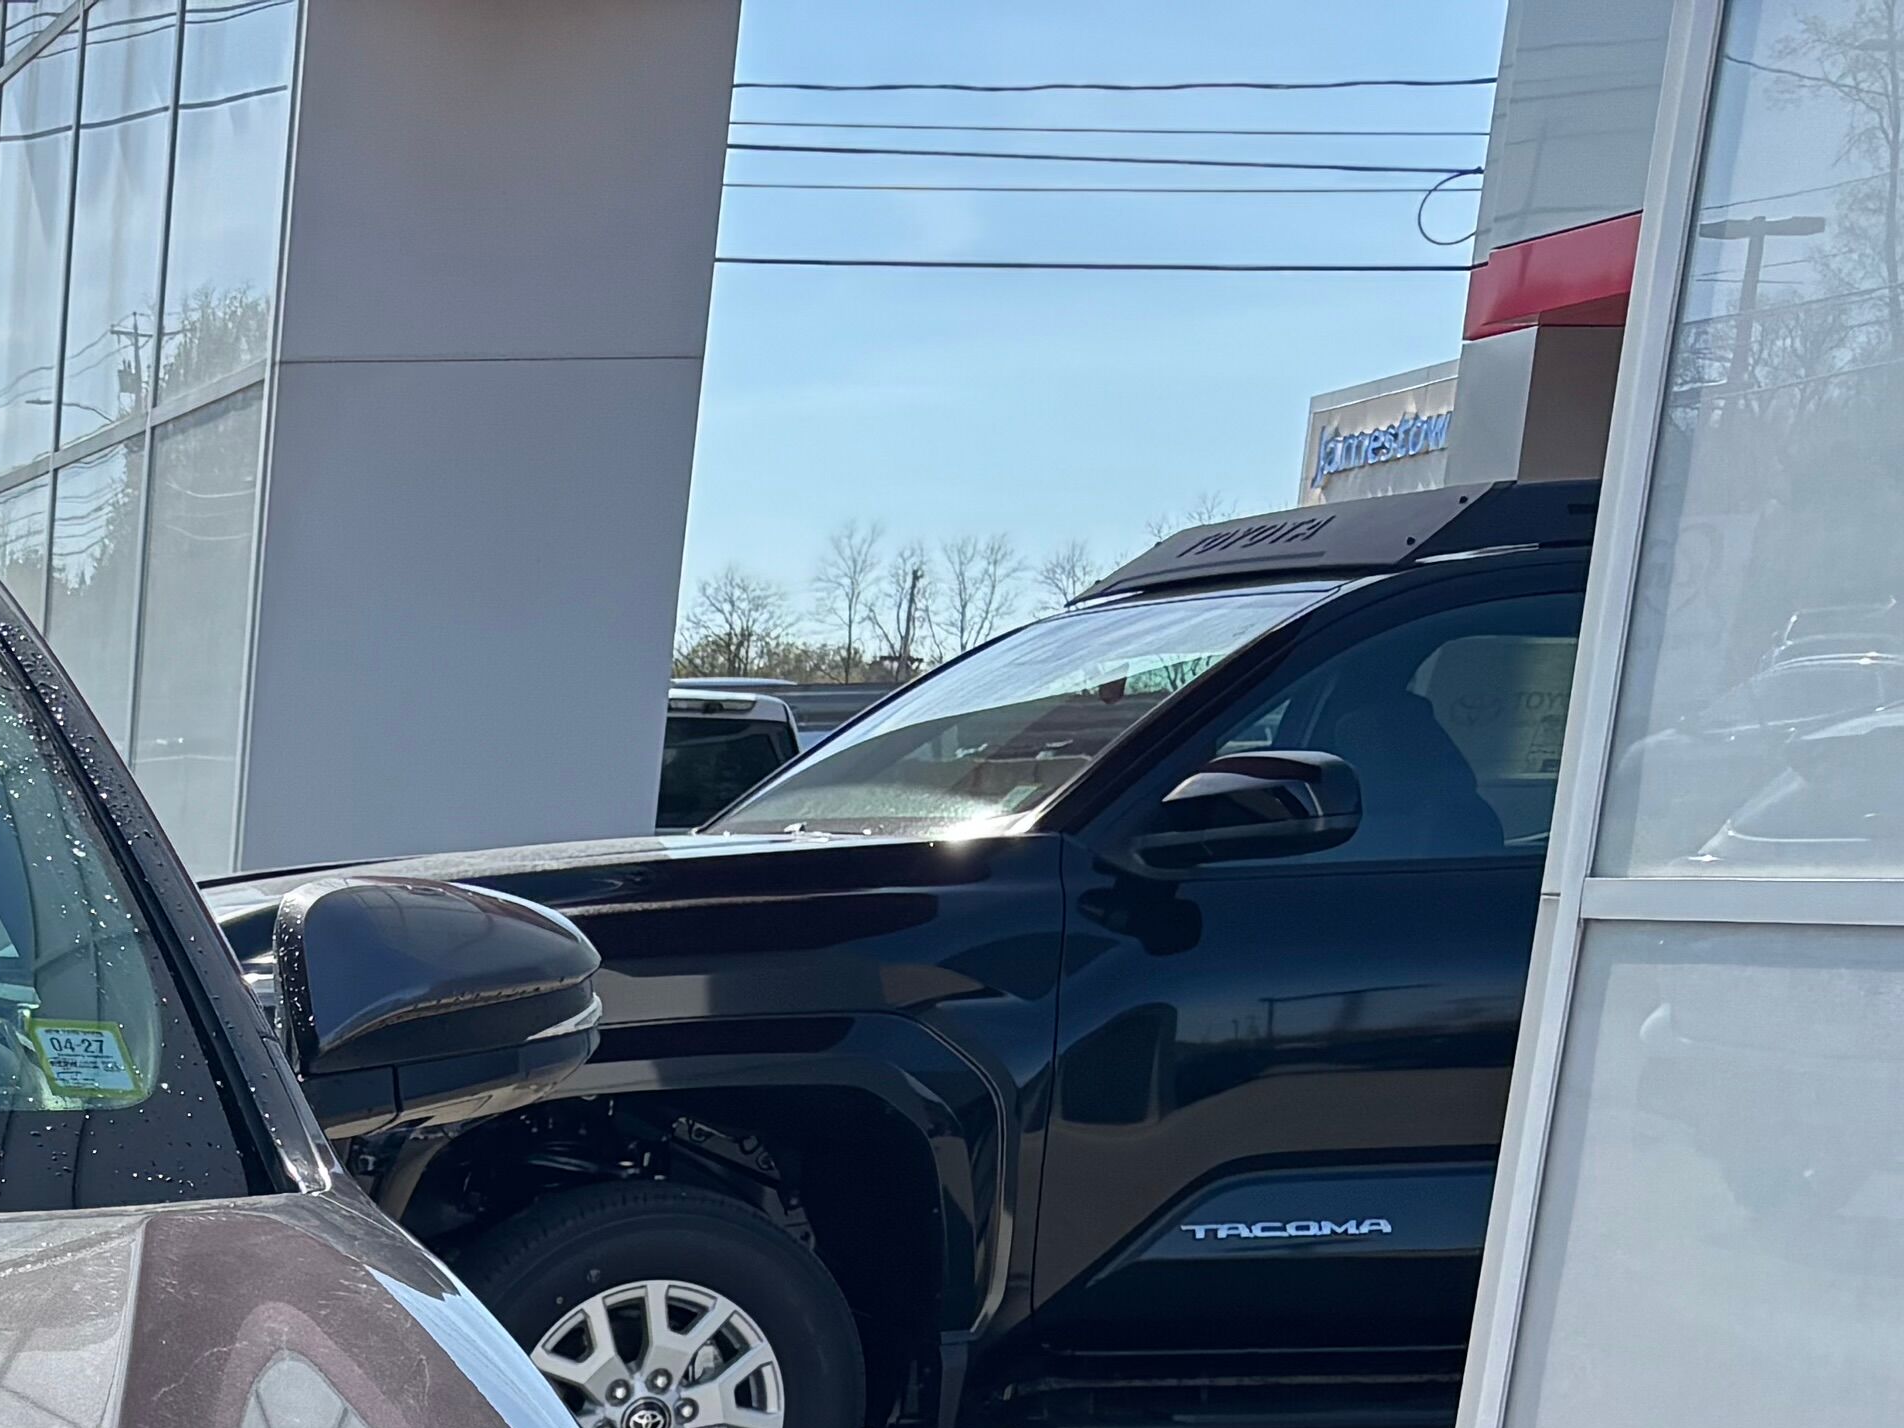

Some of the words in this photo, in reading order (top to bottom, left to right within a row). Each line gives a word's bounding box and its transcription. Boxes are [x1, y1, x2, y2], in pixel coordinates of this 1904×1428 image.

[1176, 514, 1336, 558] TOYOTA
[49, 1037, 105, 1055] 04-27
[1180, 1218, 1392, 1240] TACOMA
